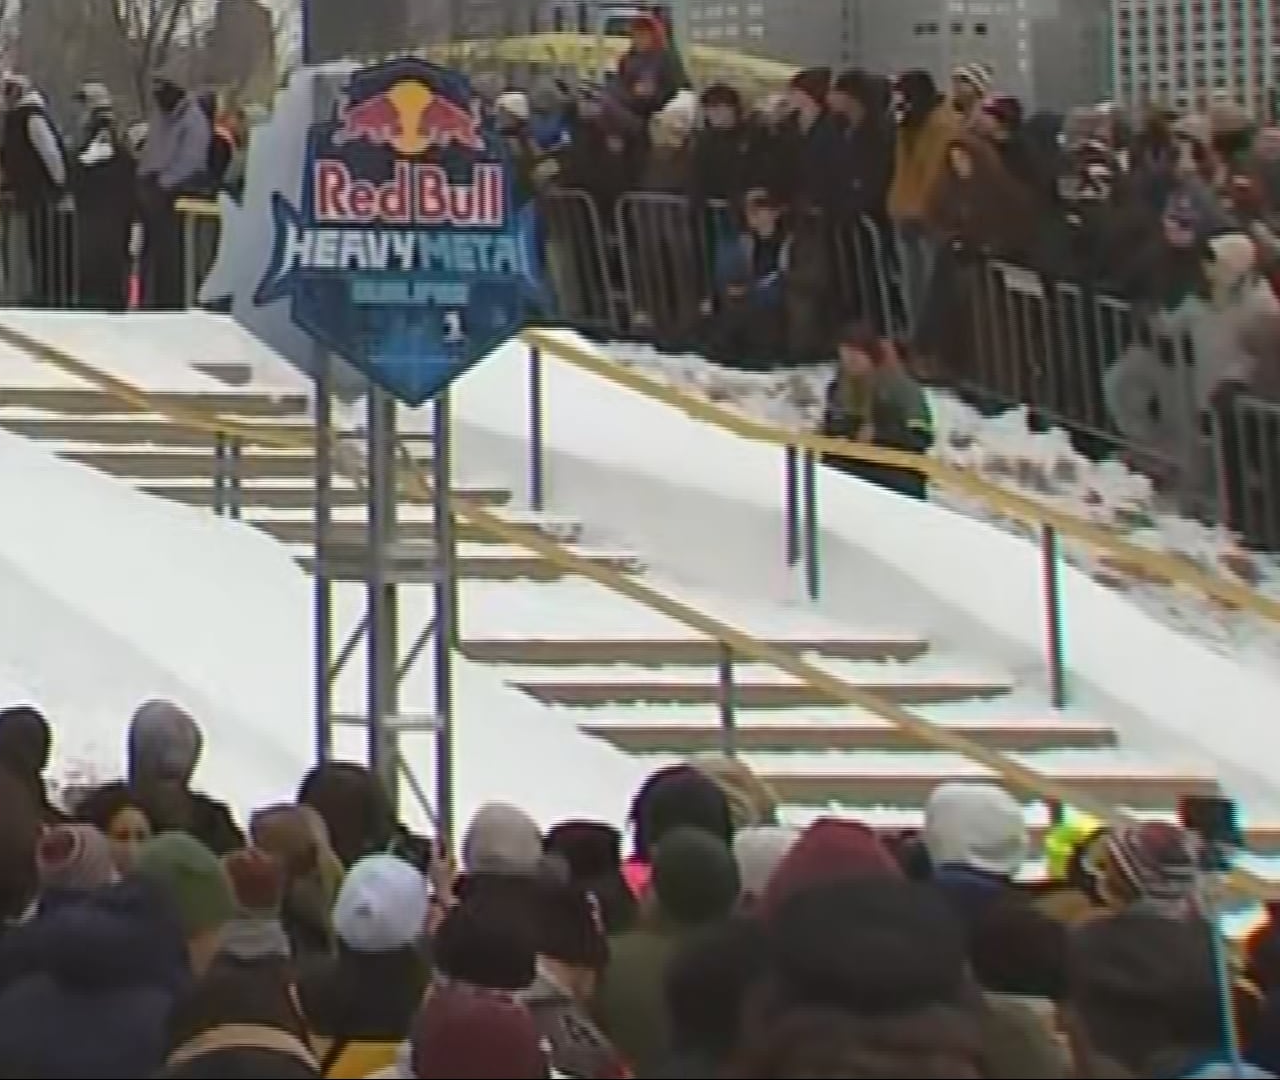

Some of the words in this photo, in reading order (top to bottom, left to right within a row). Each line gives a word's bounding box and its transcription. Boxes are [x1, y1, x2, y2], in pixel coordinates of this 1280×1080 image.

[315, 159, 411, 224] Red
[413, 163, 505, 227] Bull
[283, 226, 416, 272] HEAVY
